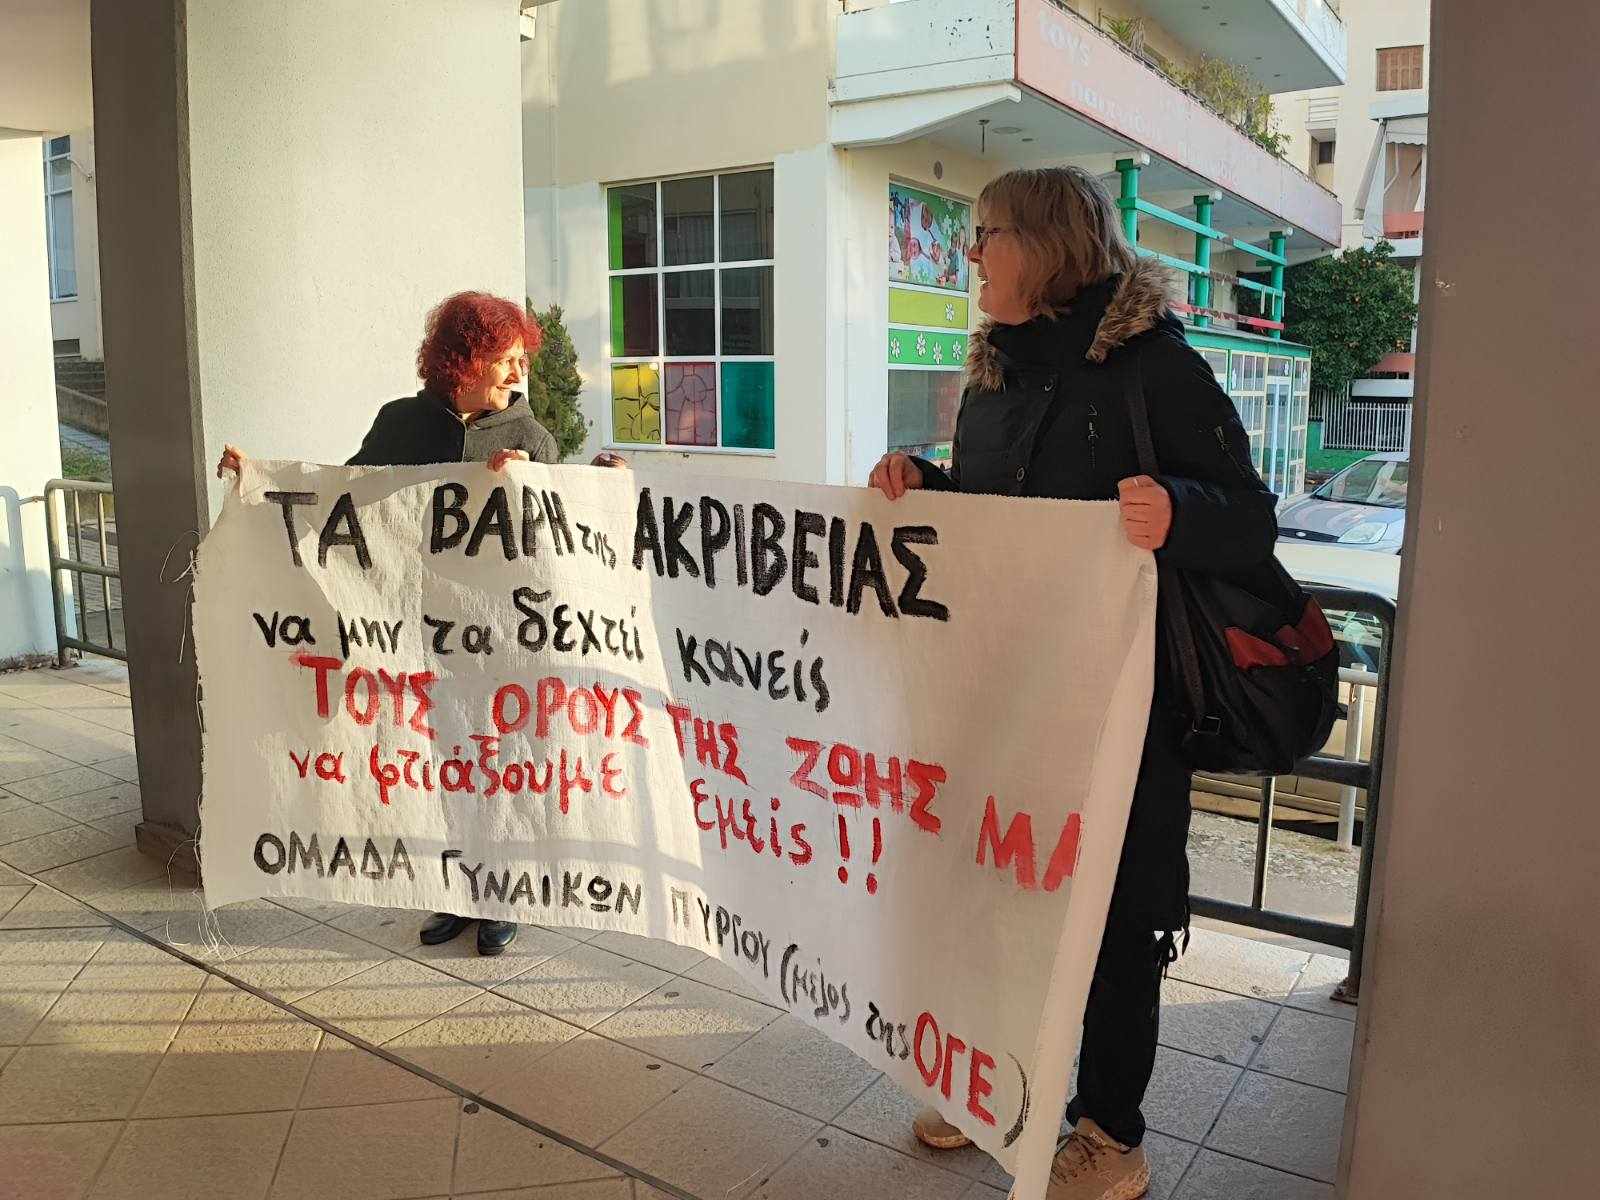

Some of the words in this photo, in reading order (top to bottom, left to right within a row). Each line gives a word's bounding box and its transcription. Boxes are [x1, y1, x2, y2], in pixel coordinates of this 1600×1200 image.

[264, 490, 372, 569] ΤΑ
[430, 482, 575, 560] ΒΑΡΗ
[576, 522, 616, 569] της
[632, 487, 950, 621] ΑΚΡΙΒΕΙΑΣ
[253, 611, 316, 647] να
[337, 611, 403, 659] μην
[424, 615, 494, 656] τα
[514, 586, 644, 661] δεχτεί
[676, 628, 830, 713] κανείς
[290, 749, 347, 784] να
[370, 734, 630, 814] φτιάξουμε
[293, 653, 439, 740] ΤΟΥΣ
[492, 677, 649, 748] ΟΡΟΥΣ
[666, 703, 749, 786] ΤΗΣ
[785, 736, 947, 834] ΖΩΗΣ
[253, 831, 415, 881] ΟΜΑΔΑ
[441, 849, 642, 915] ΓΥΝΑΙΚΩΝ
[670, 887, 770, 977] ΠΥΡΓΟΥ
[866, 1001, 910, 1060] της
